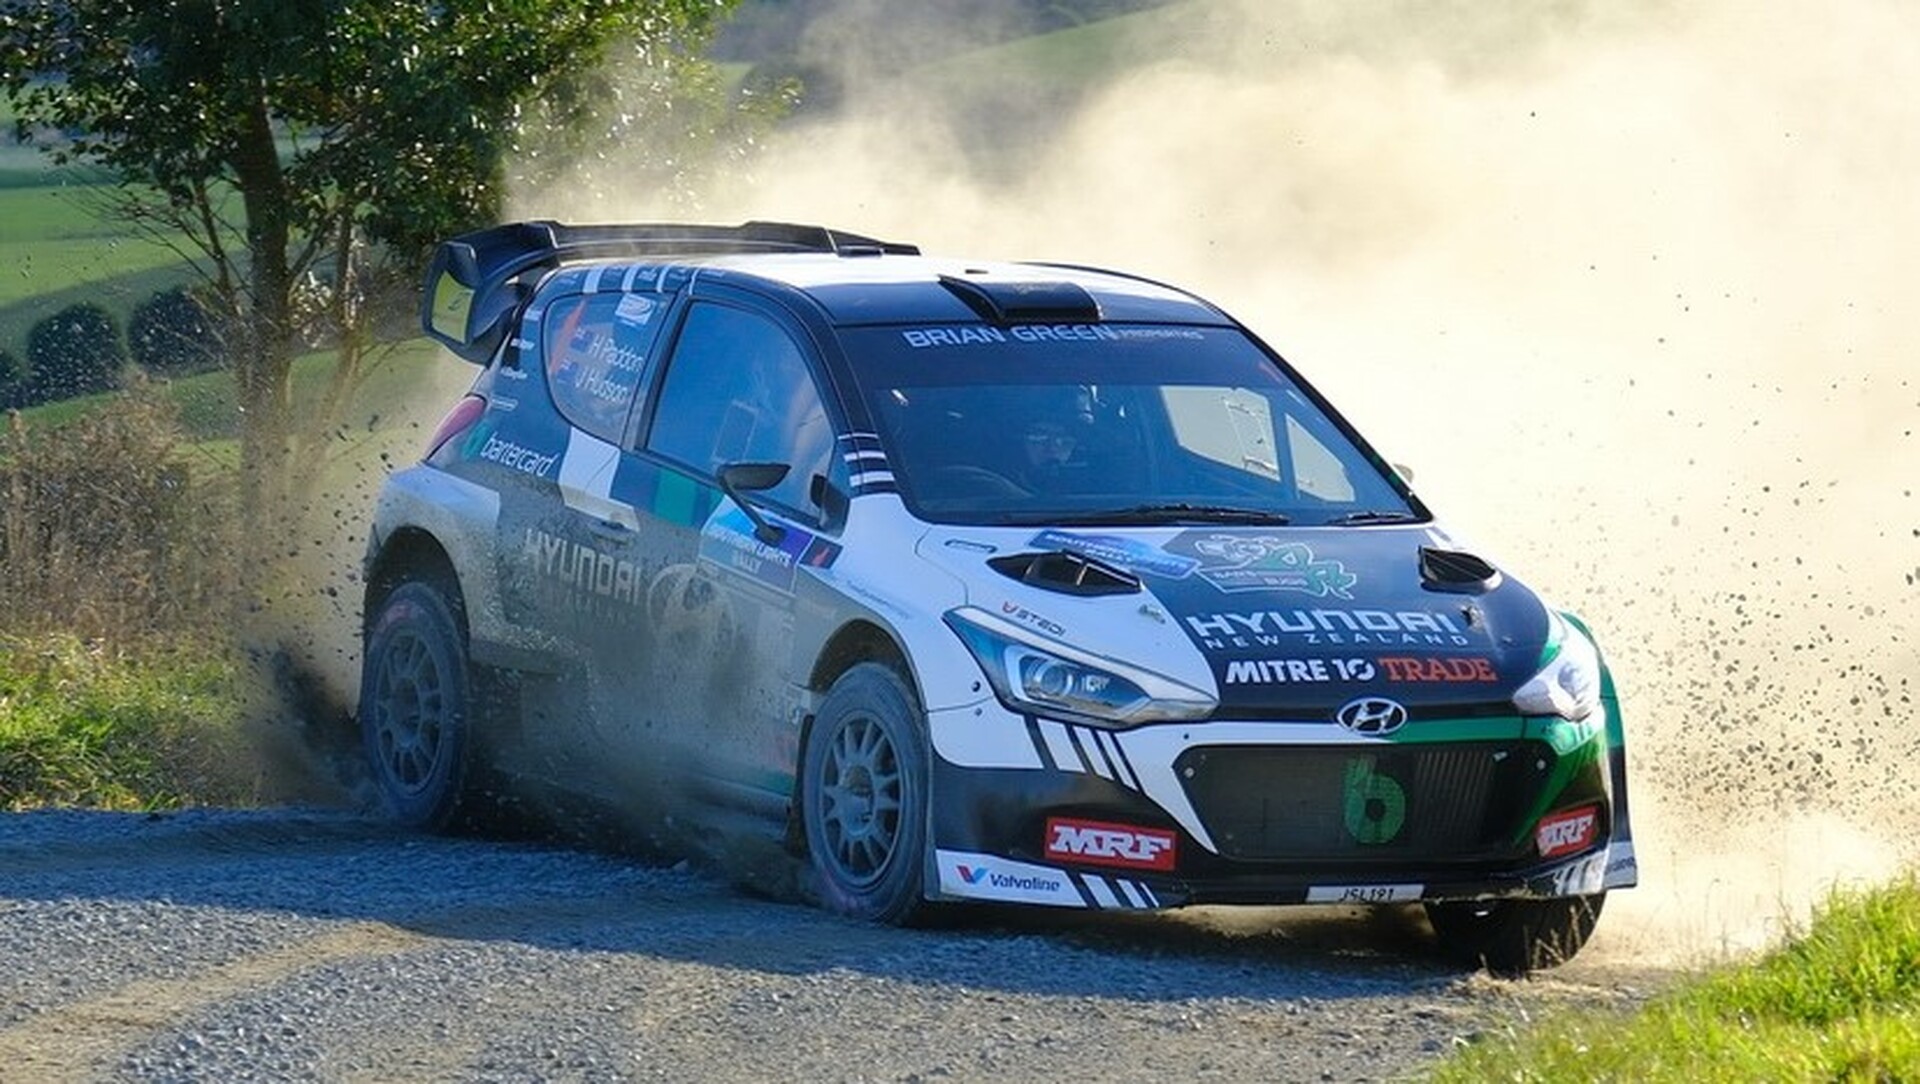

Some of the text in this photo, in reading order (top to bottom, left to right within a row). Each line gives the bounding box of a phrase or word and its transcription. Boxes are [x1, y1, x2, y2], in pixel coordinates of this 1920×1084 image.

[902, 328, 1006, 348] BRIAN
[1009, 325, 1118, 342] GREEN
[600, 337, 646, 373] Paddon
[480, 430, 561, 477] bartercard
[526, 527, 642, 607] HYUNDAI
[1186, 609, 1463, 637] HYUNDAI
[1203, 632, 1469, 650] NEW ZEALAND
[1225, 657, 1498, 684] MITRE 10 TRADE
[1049, 824, 1172, 861] MRF
[1539, 813, 1595, 856] MRF
[989, 872, 1060, 893] Valvoline
